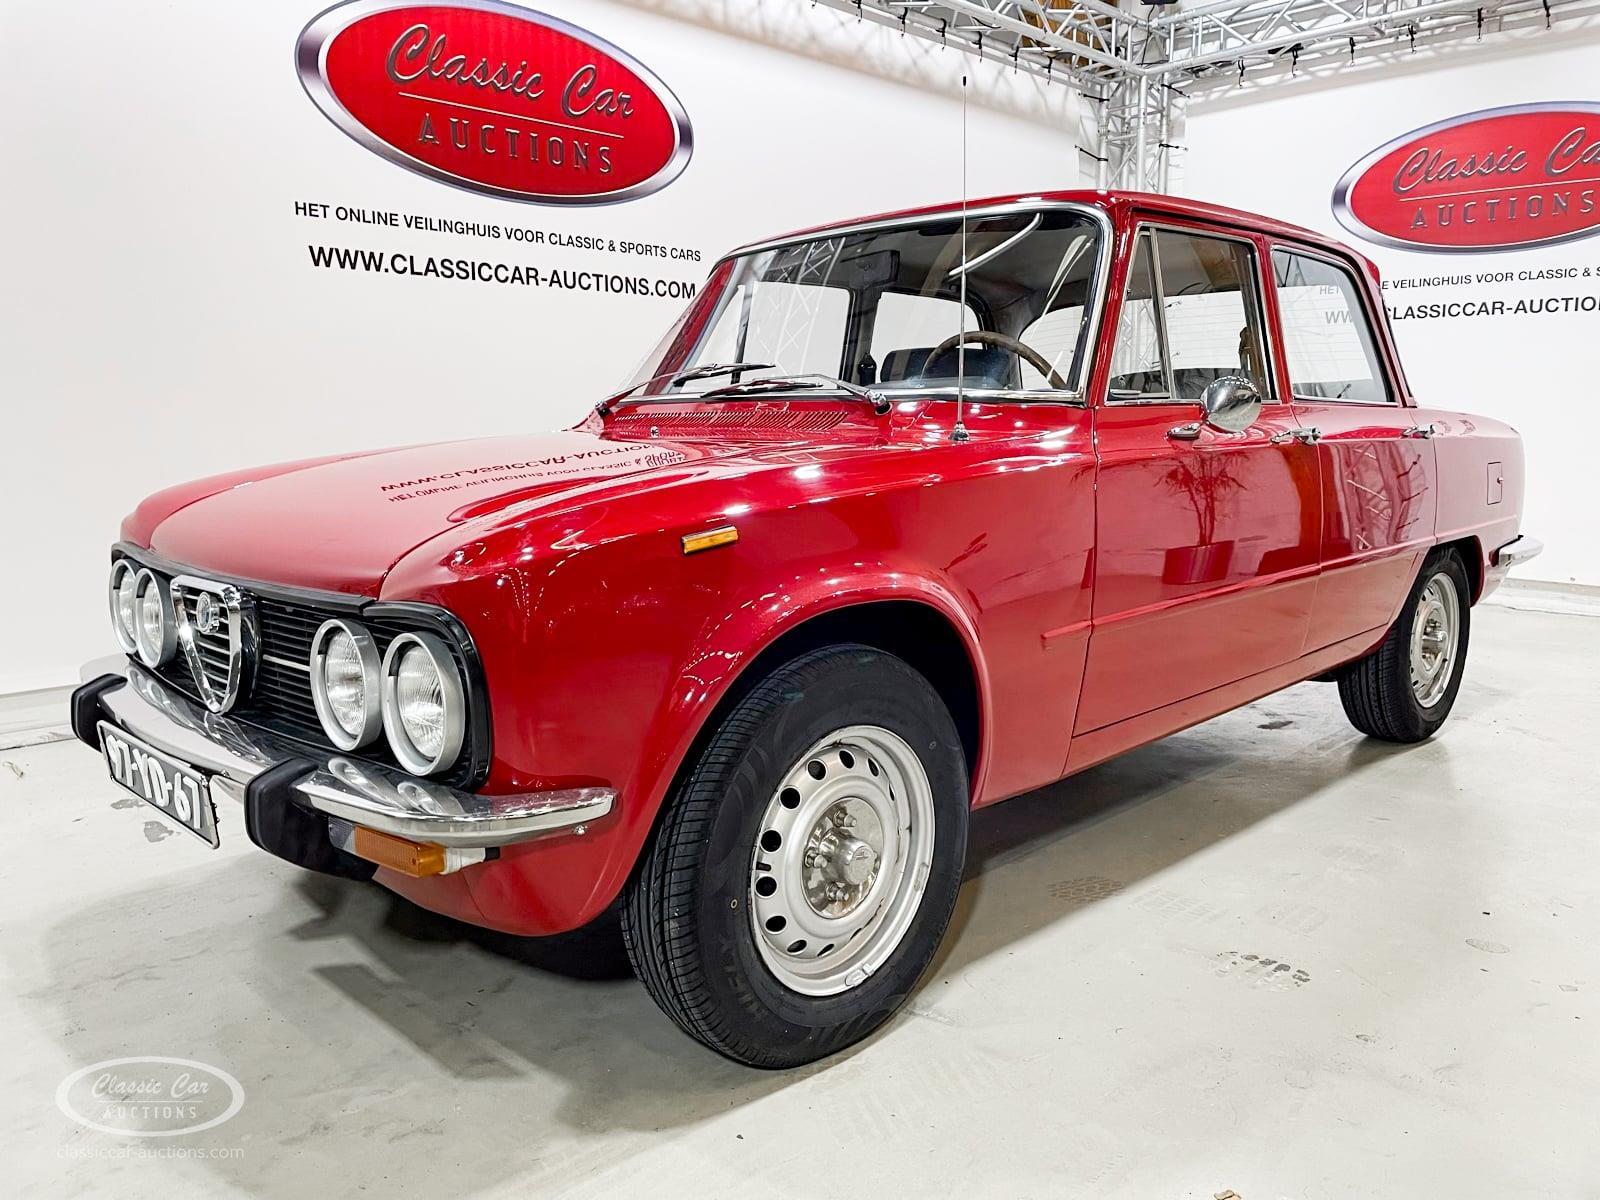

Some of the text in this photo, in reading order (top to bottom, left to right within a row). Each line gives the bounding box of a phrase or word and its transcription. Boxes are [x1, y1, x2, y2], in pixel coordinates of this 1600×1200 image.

[387, 23, 635, 119] Classic Car
[417, 112, 614, 175] AUCTIONS
[1393, 145, 1528, 194] Classic
[294, 201, 702, 262] HET ONLINE VEILINGHUIS VOOR CLASSIC & SPORTS CARS
[1410, 189, 1594, 230] AUCTIONS
[308, 245, 696, 300] WWW.CLASSICCAR-AUCTIONS.COM
[1392, 274, 1472, 289] VEILINGHUIS
[1476, 271, 1514, 284] VOOR
[1518, 267, 1578, 281] CLASSIC
[1582, 266, 1591, 277] &
[106, 734, 202, 830] 97-YD-67
